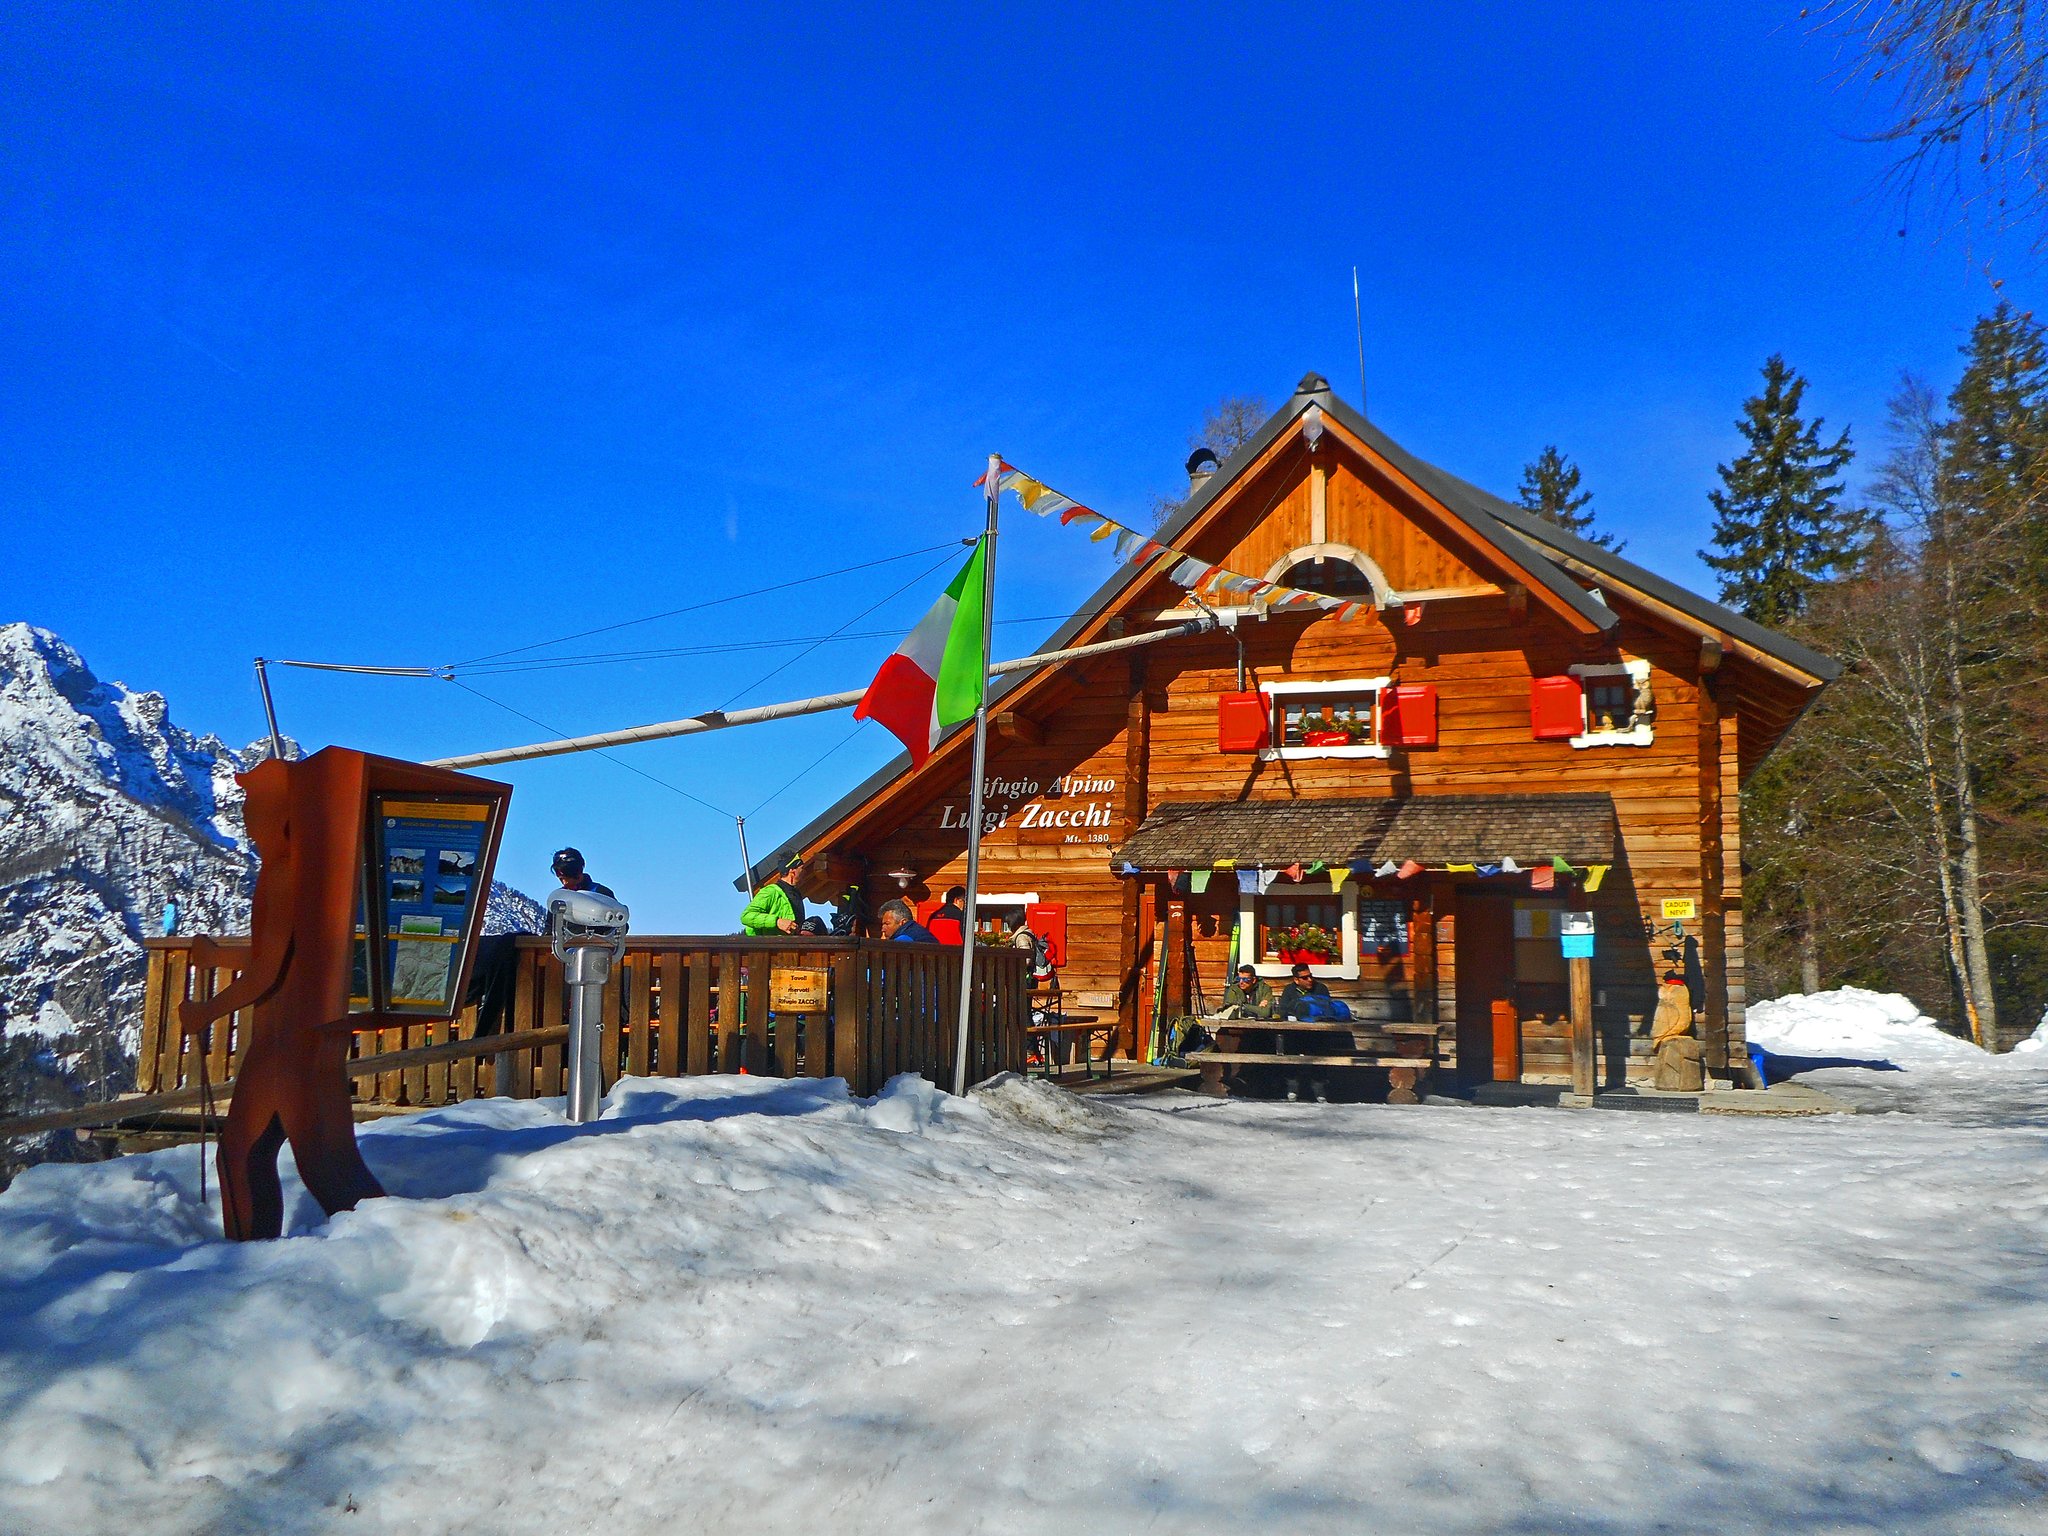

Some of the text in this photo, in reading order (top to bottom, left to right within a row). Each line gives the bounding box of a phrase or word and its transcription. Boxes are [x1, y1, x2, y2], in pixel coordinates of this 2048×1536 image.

[969, 774, 1116, 800] ifugio Alpino
[1019, 801, 1113, 830] Zacchi
[1064, 833, 1110, 844] Mt. 1380
